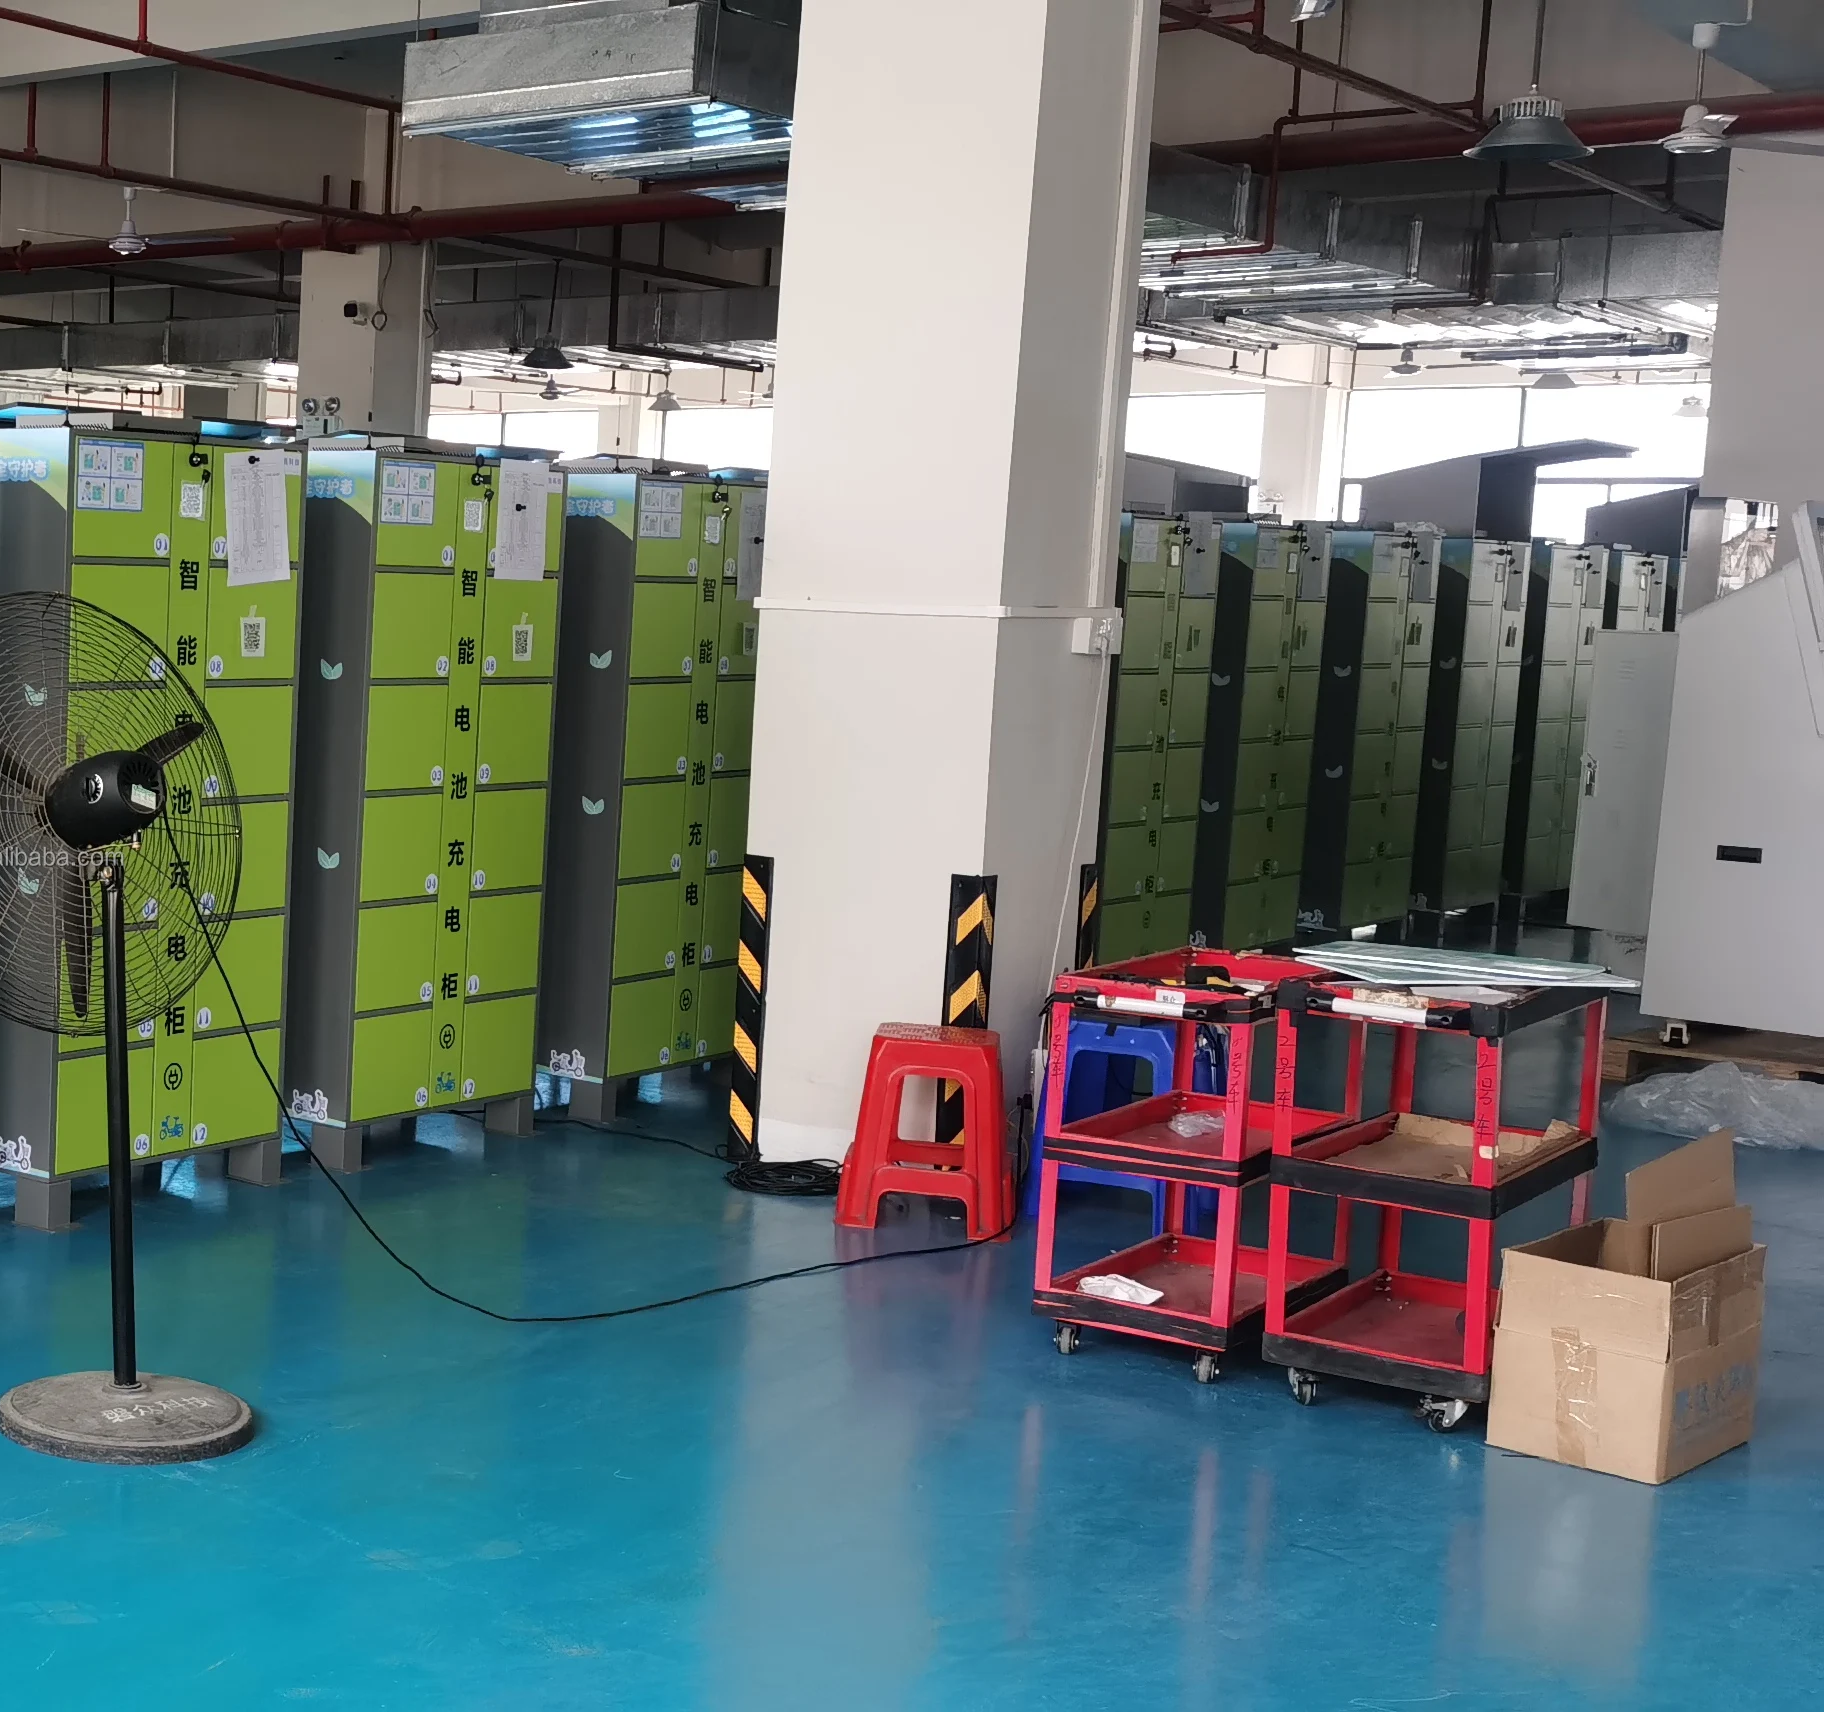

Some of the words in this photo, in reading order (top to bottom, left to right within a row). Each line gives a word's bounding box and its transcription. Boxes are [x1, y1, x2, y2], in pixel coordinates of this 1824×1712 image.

[215, 541, 227, 554] 07
[441, 568, 478, 1000] 智能电池充电柜
[682, 577, 716, 967] 智能电池充电柜
[1276, 1035, 1296, 1113] 2号车
[1476, 1053, 1496, 1141] 2号车
